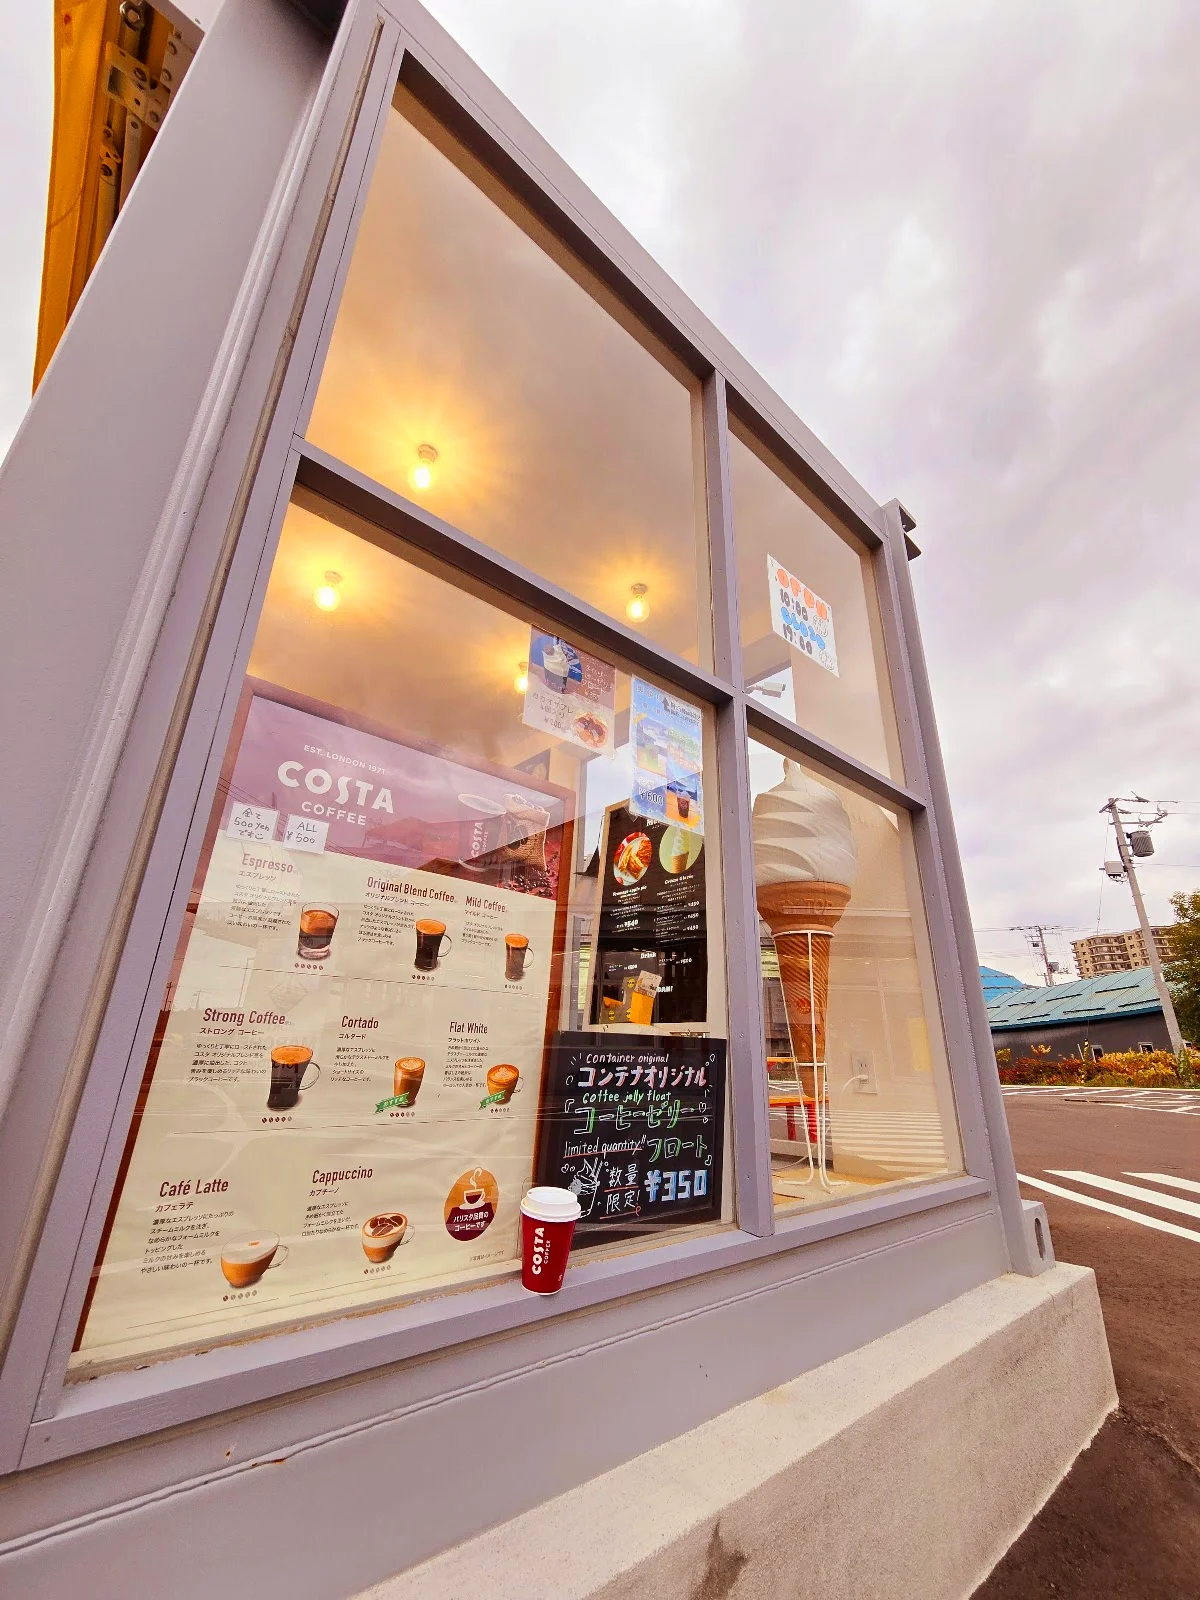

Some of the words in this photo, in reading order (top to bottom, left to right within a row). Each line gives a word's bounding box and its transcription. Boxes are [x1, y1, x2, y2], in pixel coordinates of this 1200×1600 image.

[780, 588, 809, 621] 10:00
[304, 744, 323, 756] EST.
[326, 751, 366, 769] LONDON
[368, 764, 386, 775] 1971
[277, 760, 394, 814] COSTA
[234, 816, 253, 828] 500
[242, 807, 261, 820] 全て
[301, 801, 367, 826] COFFEE
[296, 821, 318, 833] ALL
[241, 853, 294, 873] Espresso
[238, 870, 277, 881] エスプレッソ
[367, 876, 403, 893] Original
[404, 883, 428, 898] Blend
[429, 888, 455, 903] Coffee
[465, 895, 482, 908] Mild
[483, 899, 506, 913] Coffee
[640, 951, 657, 959] Drink
[203, 1007, 245, 1026] Strong
[248, 1010, 286, 1025] Coffee
[341, 1015, 379, 1029] Cortado
[199, 1027, 236, 1036] ストロング
[449, 1021, 465, 1033] Flat
[467, 1022, 488, 1034] White
[637, 1053, 670, 1064] original
[577, 1065, 707, 1089] コンテナオリジナル
[622, 1089, 645, 1106] jelly
[646, 1088, 672, 1103] float
[564, 1136, 600, 1158] limited
[312, 1165, 373, 1186] Cappuccino
[608, 1163, 637, 1187] 数量
[159, 1179, 192, 1198] Café
[195, 1178, 229, 1195] Latte
[308, 1187, 340, 1198] カプチーノ
[643, 1169, 708, 1203] ¥350
[155, 1201, 194, 1213] カフェラテ
[453, 1211, 489, 1223] バリスタ品質の
[147, 1230, 220, 1245] なめらかなフォームミルクを
[144, 1243, 184, 1254] トッピングした
[531, 1227, 545, 1275] COSTA
[543, 1240, 551, 1264] COFFEE
